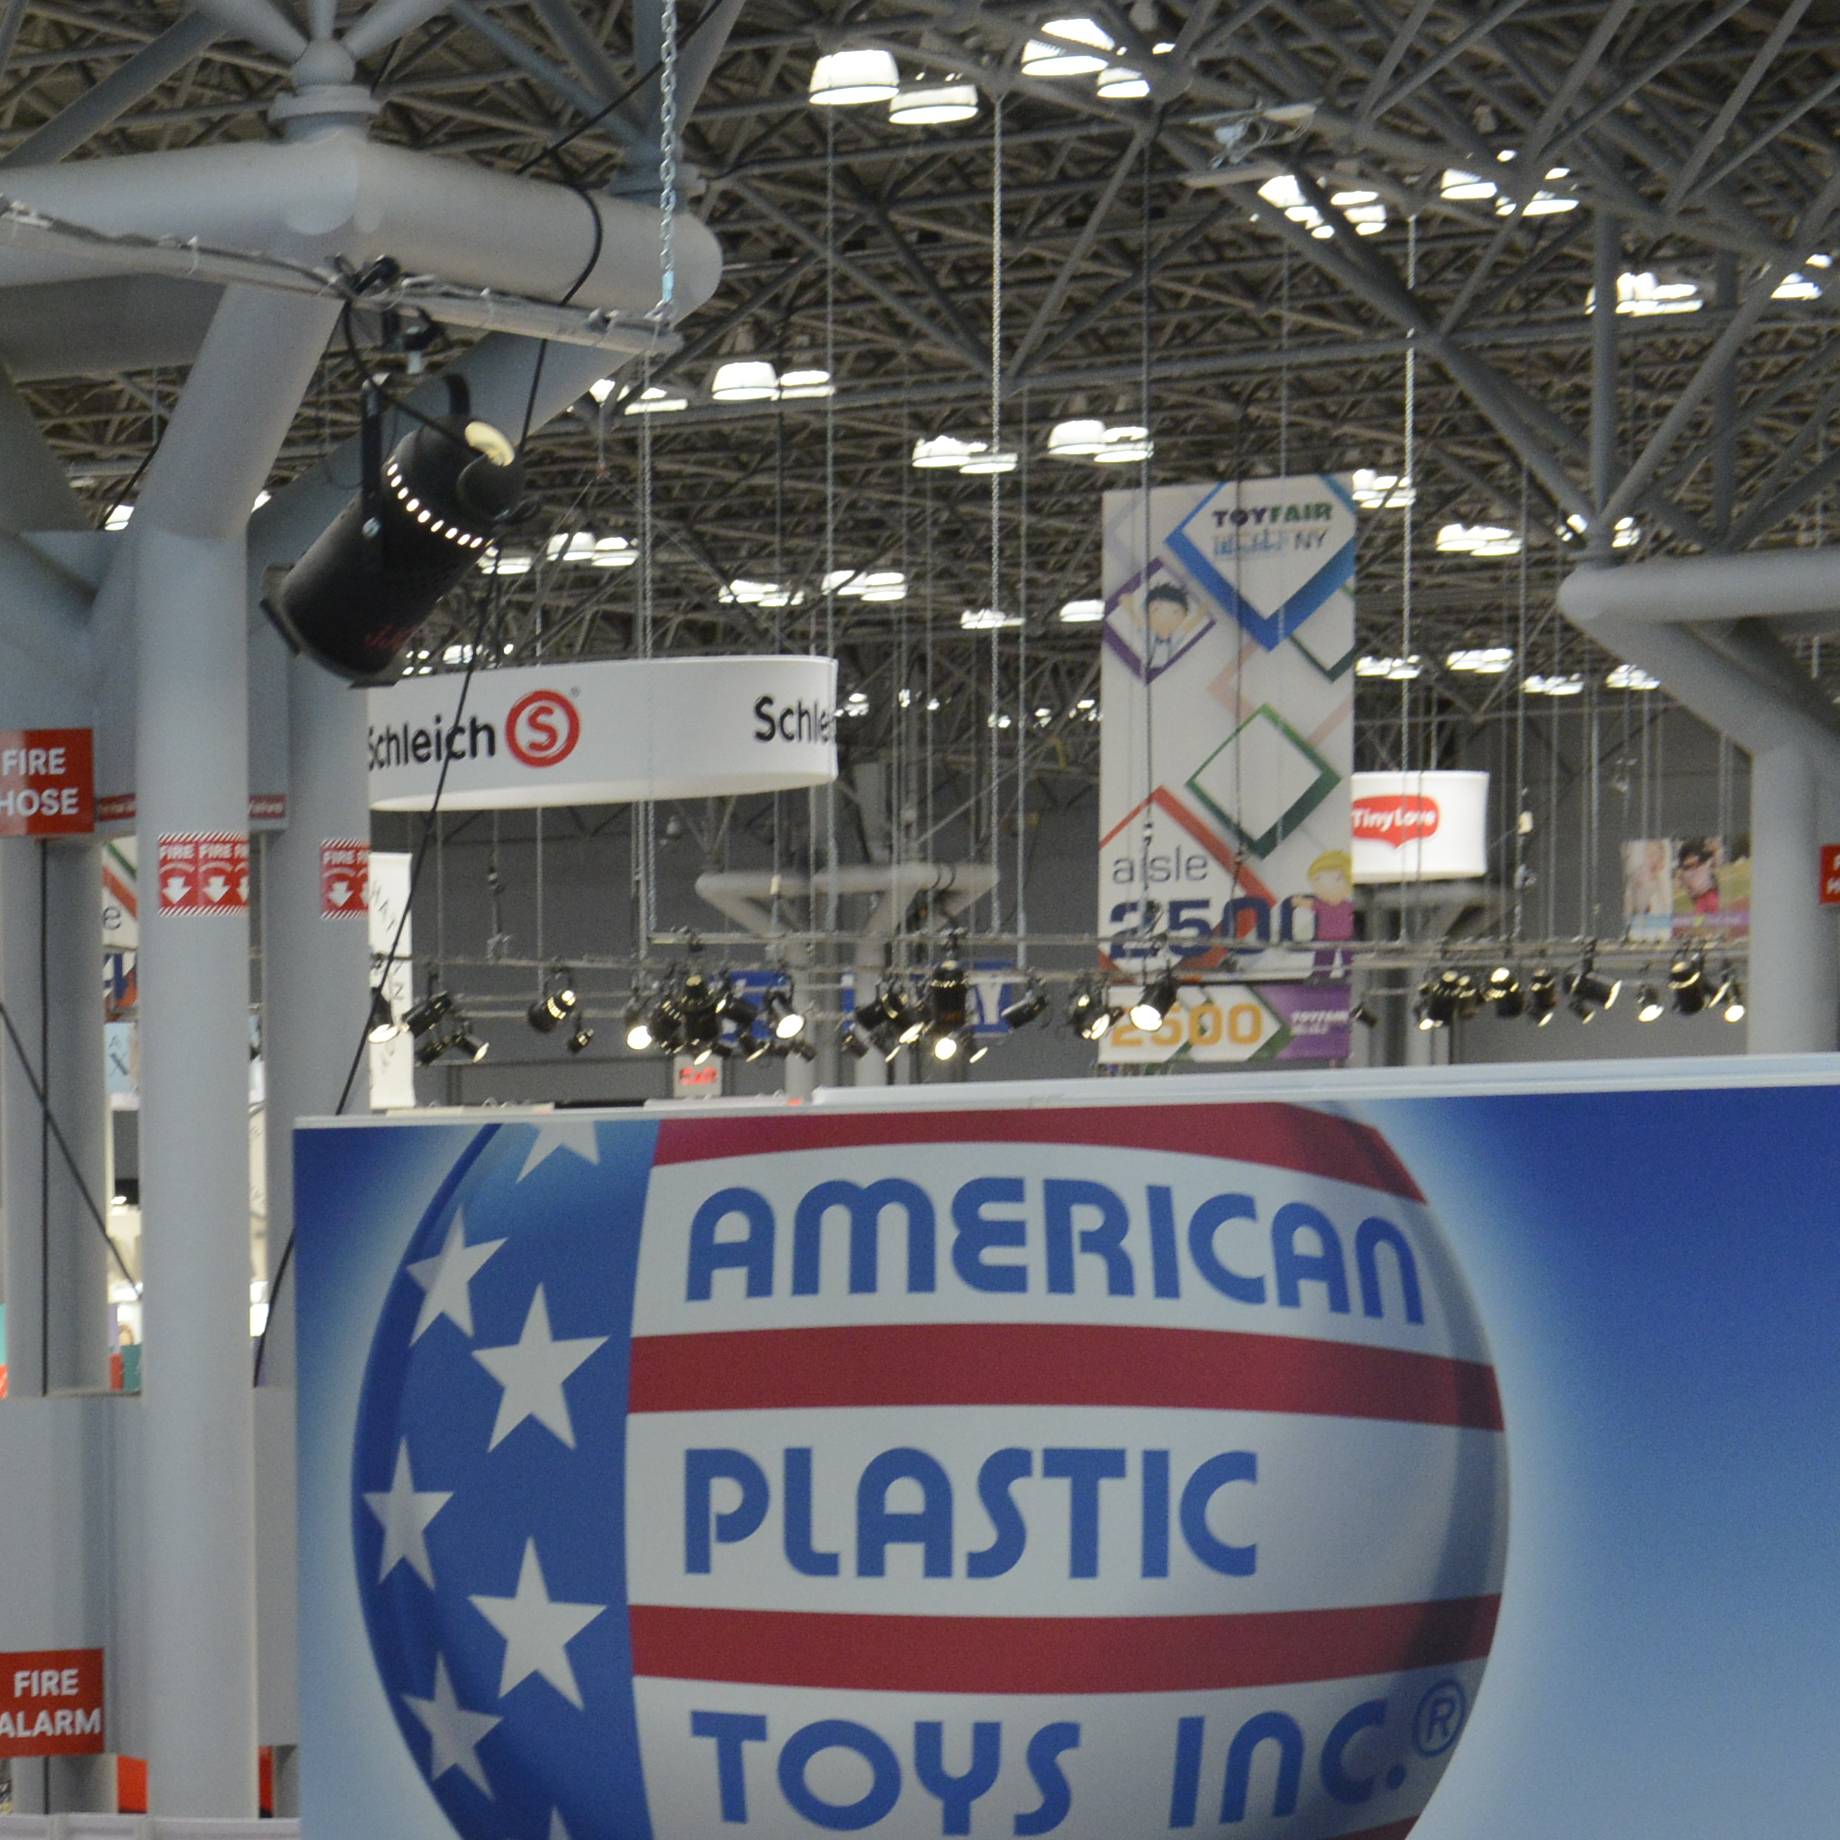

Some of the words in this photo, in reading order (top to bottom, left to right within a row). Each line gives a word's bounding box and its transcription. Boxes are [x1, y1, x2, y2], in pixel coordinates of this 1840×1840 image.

[1212, 502, 1332, 527] TOYFAIR
[1293, 528, 1328, 549] NY
[1, 747, 66, 776] FIRE
[160, 844, 196, 861] FIRE
[199, 843, 233, 859] FIRE
[1112, 844, 1209, 884] aisle
[684, 1175, 1427, 1326] AMERICAN
[682, 1444, 1258, 1580] PLASTIC
[13, 1668, 79, 1699] FIRE
[689, 1708, 1081, 1838] TOYS
[1168, 1703, 1410, 1829] INC.
